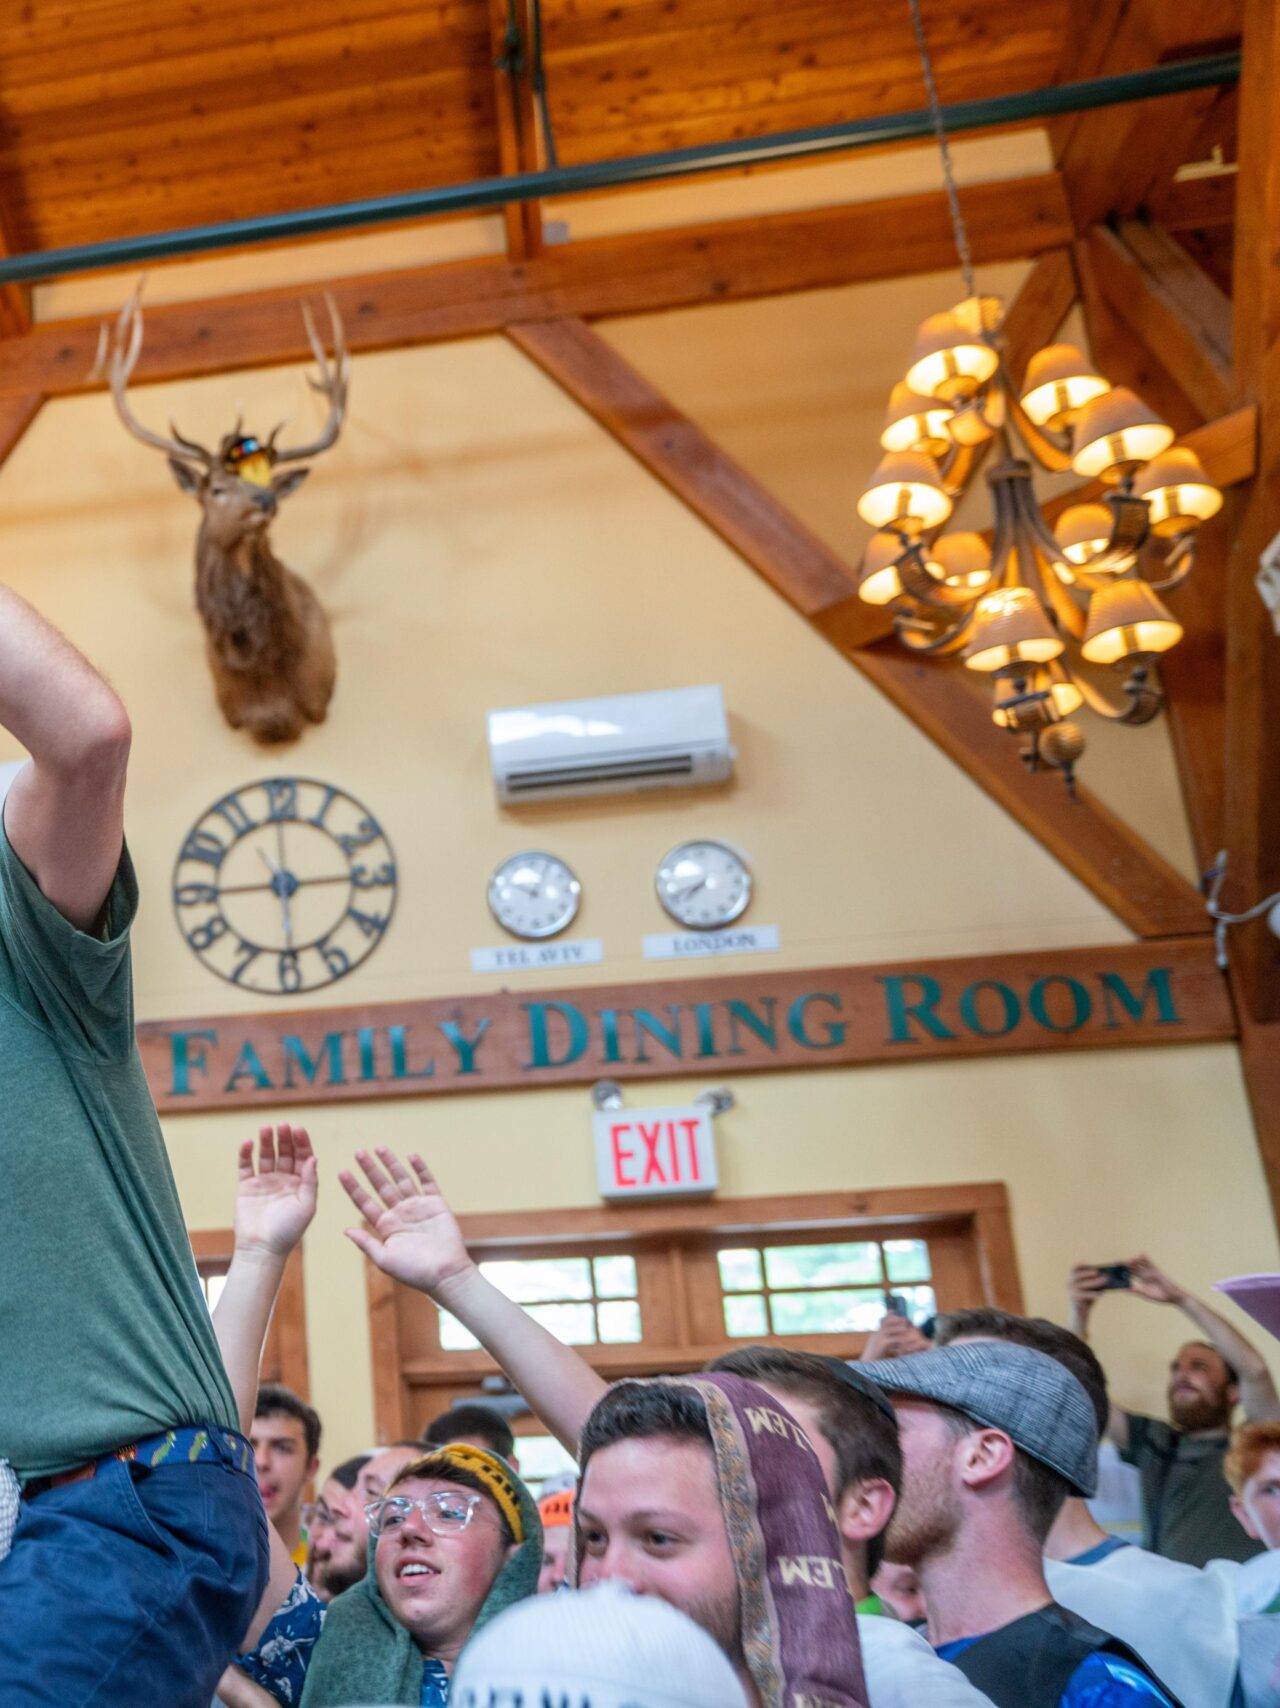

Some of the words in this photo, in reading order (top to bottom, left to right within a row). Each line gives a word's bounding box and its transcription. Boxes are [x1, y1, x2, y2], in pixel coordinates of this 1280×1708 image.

[263, 779, 299, 821] 12
[309, 785, 337, 827] 1
[340, 816, 383, 855] 2
[175, 883, 219, 907] 9
[351, 863, 397, 889] 3
[187, 915, 229, 951] 8
[346, 908, 387, 939] 4
[672, 932, 757, 953] LONDON
[233, 941, 263, 983] 7
[277, 949, 302, 992] 6
[315, 936, 352, 979] 5
[536, 946, 582, 963] AVIV
[167, 1018, 491, 1096] FAMILY
[521, 991, 849, 1070] DINING
[875, 966, 1187, 1045] ROOM
[609, 1119, 702, 1187] EXIT
